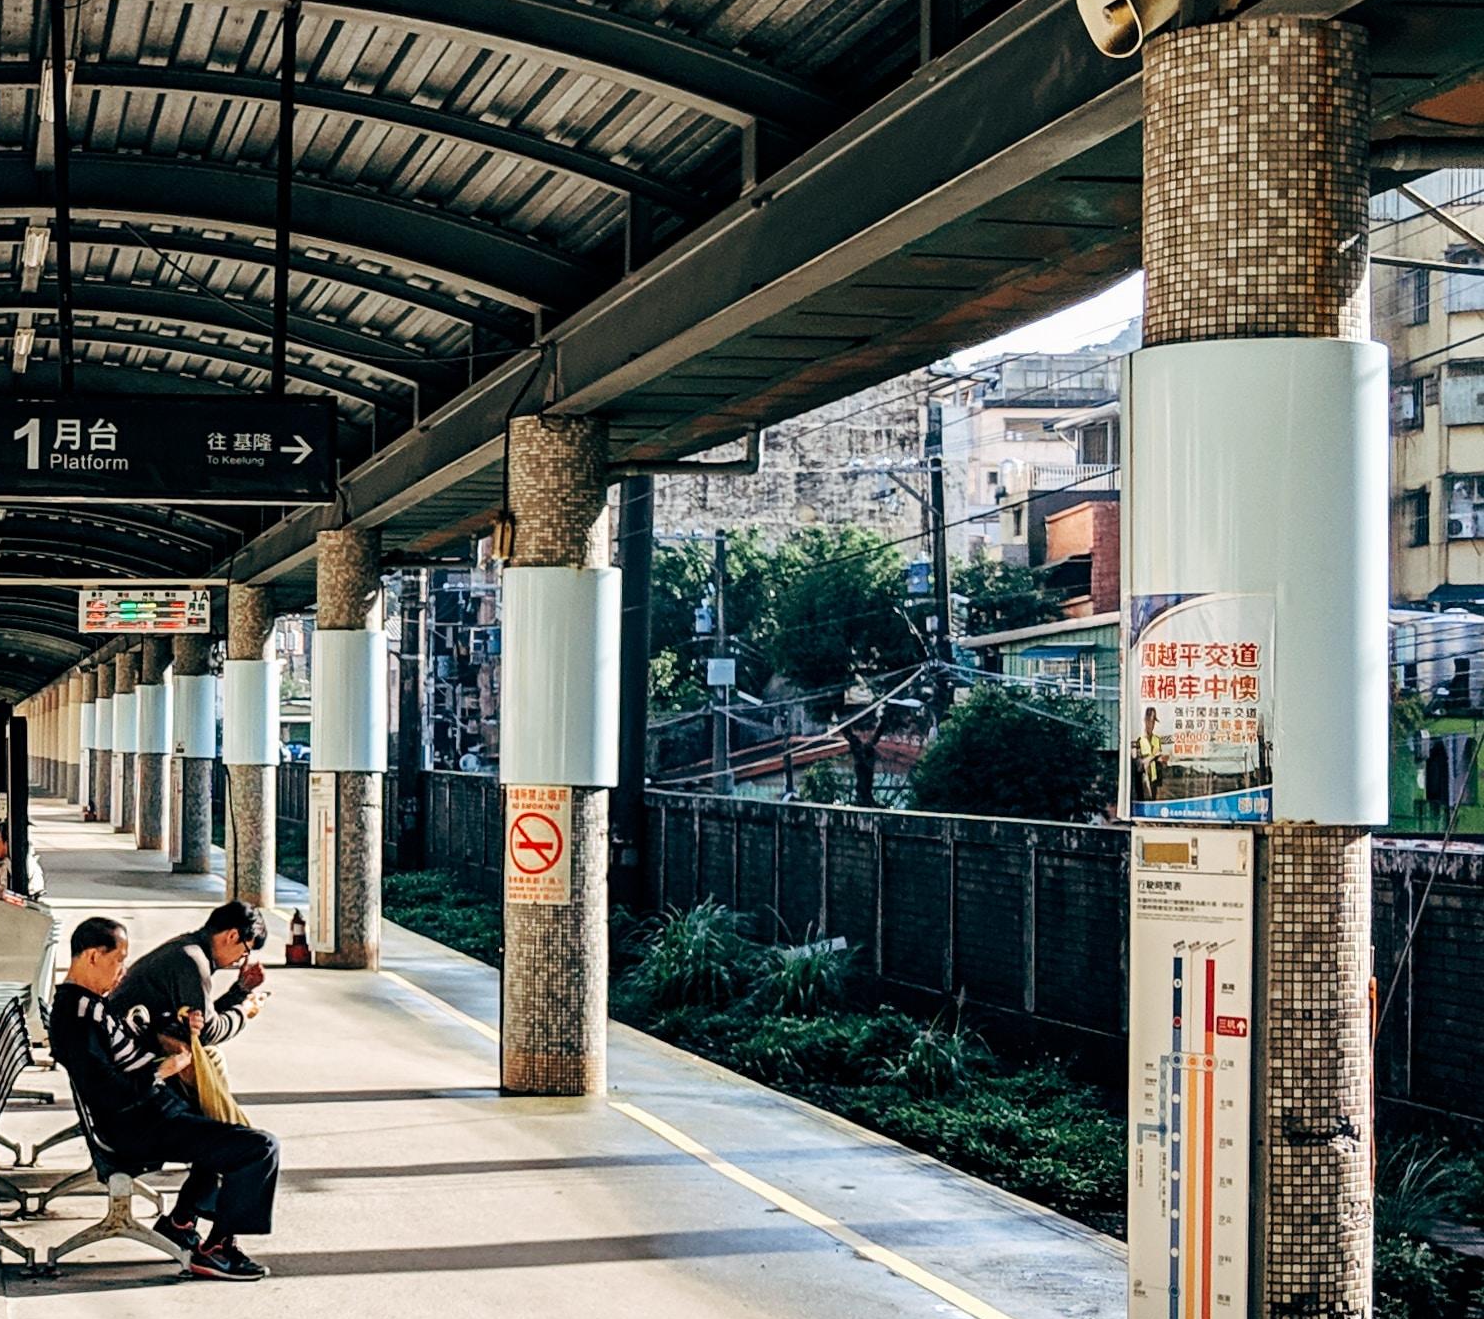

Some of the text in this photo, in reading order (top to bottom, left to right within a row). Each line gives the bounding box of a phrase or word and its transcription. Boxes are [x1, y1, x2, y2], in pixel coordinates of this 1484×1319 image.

[13, 418, 119, 469] 1 月台
[207, 432, 273, 452] 往 基隆
[49, 453, 129, 470] Platform
[206, 455, 265, 467] To Keelung
[192, 591, 209, 602] 1A
[1142, 642, 1258, 668] 闖越平交道
[1141, 674, 1257, 700] 釀禍牢中懊
